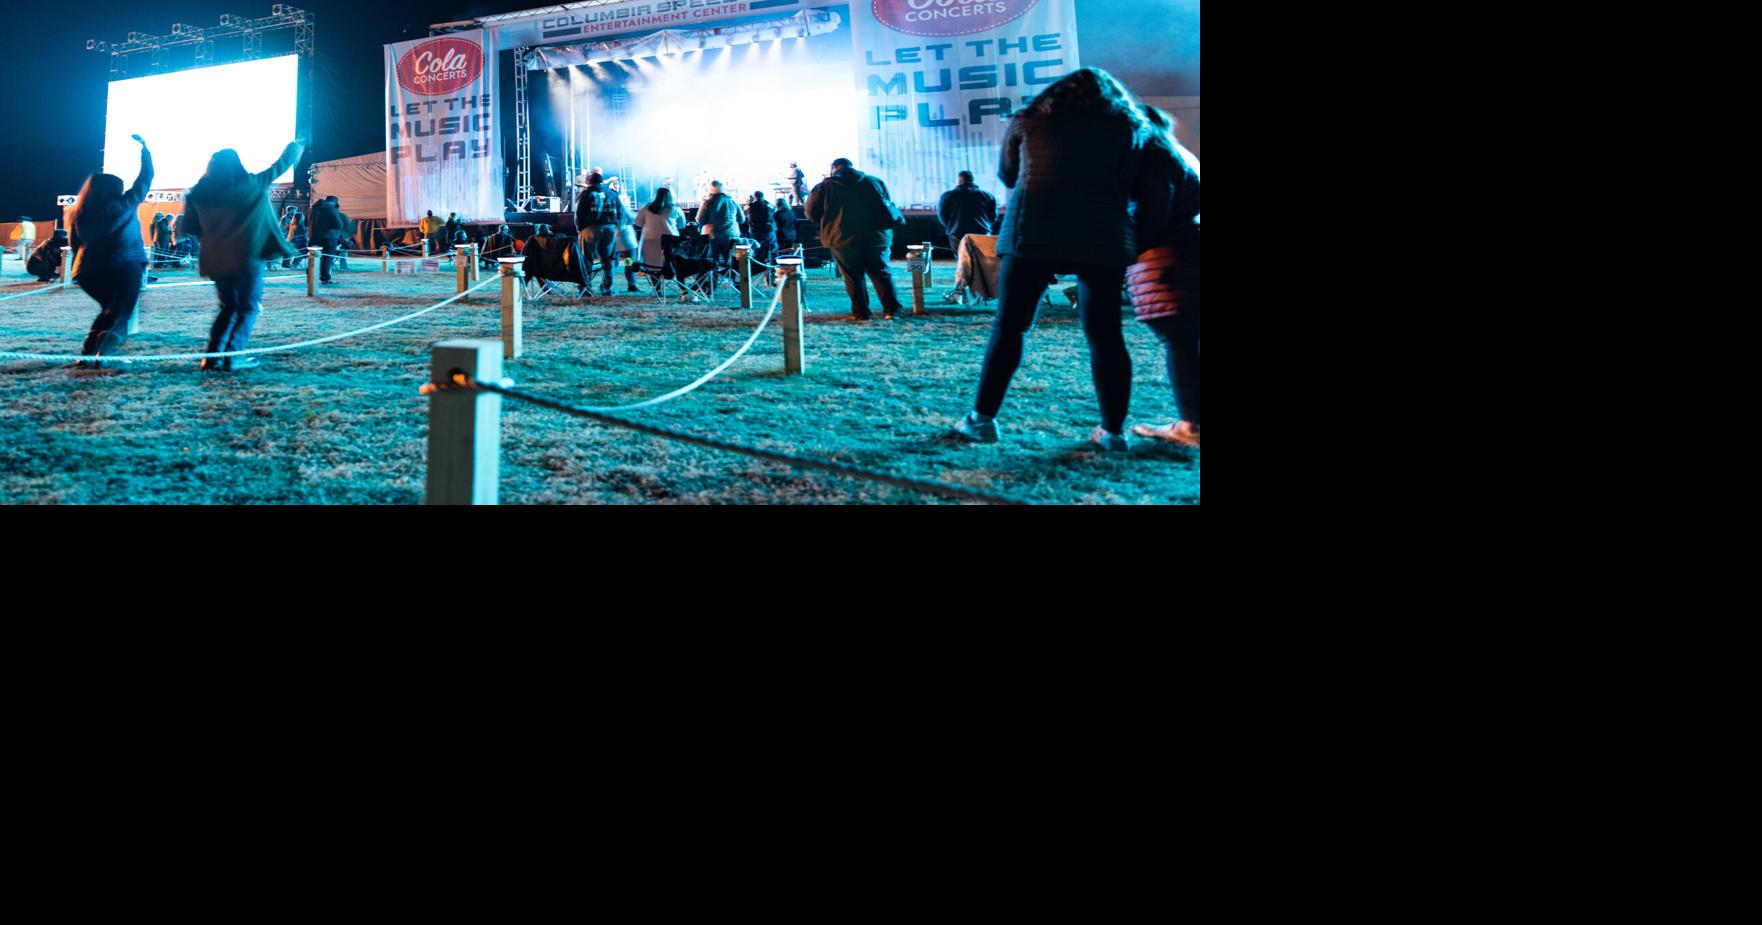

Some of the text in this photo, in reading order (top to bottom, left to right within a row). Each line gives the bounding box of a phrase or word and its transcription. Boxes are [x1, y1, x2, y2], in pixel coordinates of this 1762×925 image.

[542, 5, 650, 29] COLUMBIA
[583, 3, 747, 33] ENTERTAINMENT CENTER
[905, 1, 1006, 22] CONCERTS
[415, 48, 467, 75] Cola
[865, 33, 1062, 66] LET THE
[413, 69, 467, 85] CONCERTS
[866, 58, 1063, 96] MUSIC
[390, 94, 491, 117] LET THE
[870, 95, 1036, 130] PLA
[390, 112, 491, 139] MUSIC
[390, 138, 491, 164] PLAY
